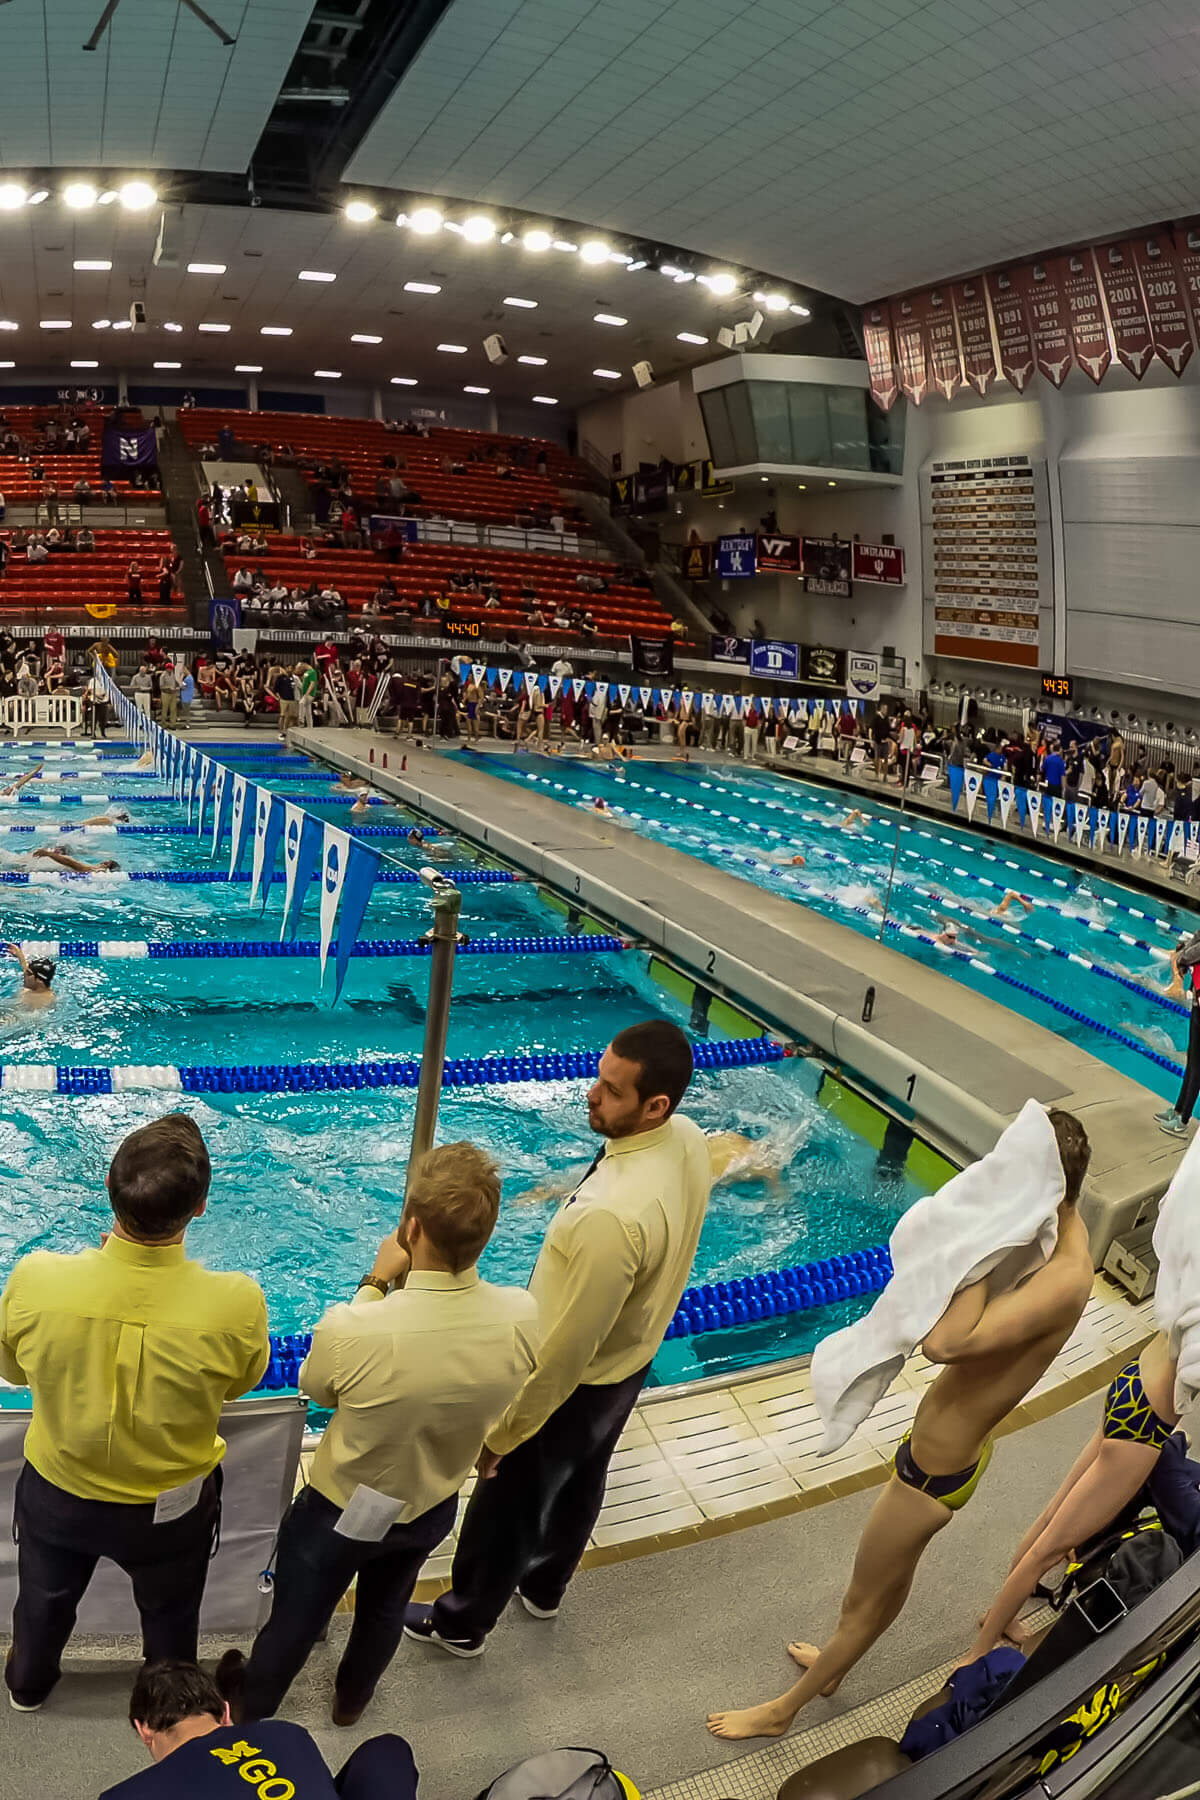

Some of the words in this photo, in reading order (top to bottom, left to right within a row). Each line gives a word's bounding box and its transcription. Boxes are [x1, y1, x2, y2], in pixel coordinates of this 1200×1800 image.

[1109, 286, 1138, 303] 2001
[1148, 281, 1177, 297] 2002
[1070, 294, 1097, 311] 2000
[761, 538, 792, 556] VT
[859, 546, 896, 559] INDIANA
[447, 622, 480, 637] 44:40
[767, 651, 783, 668] D
[854, 661, 874, 671] LSU
[1043, 679, 1069, 695] 44:39
[574, 876, 581, 893] 3
[706, 951, 717, 974] 2
[906, 1074, 917, 1102] 1
